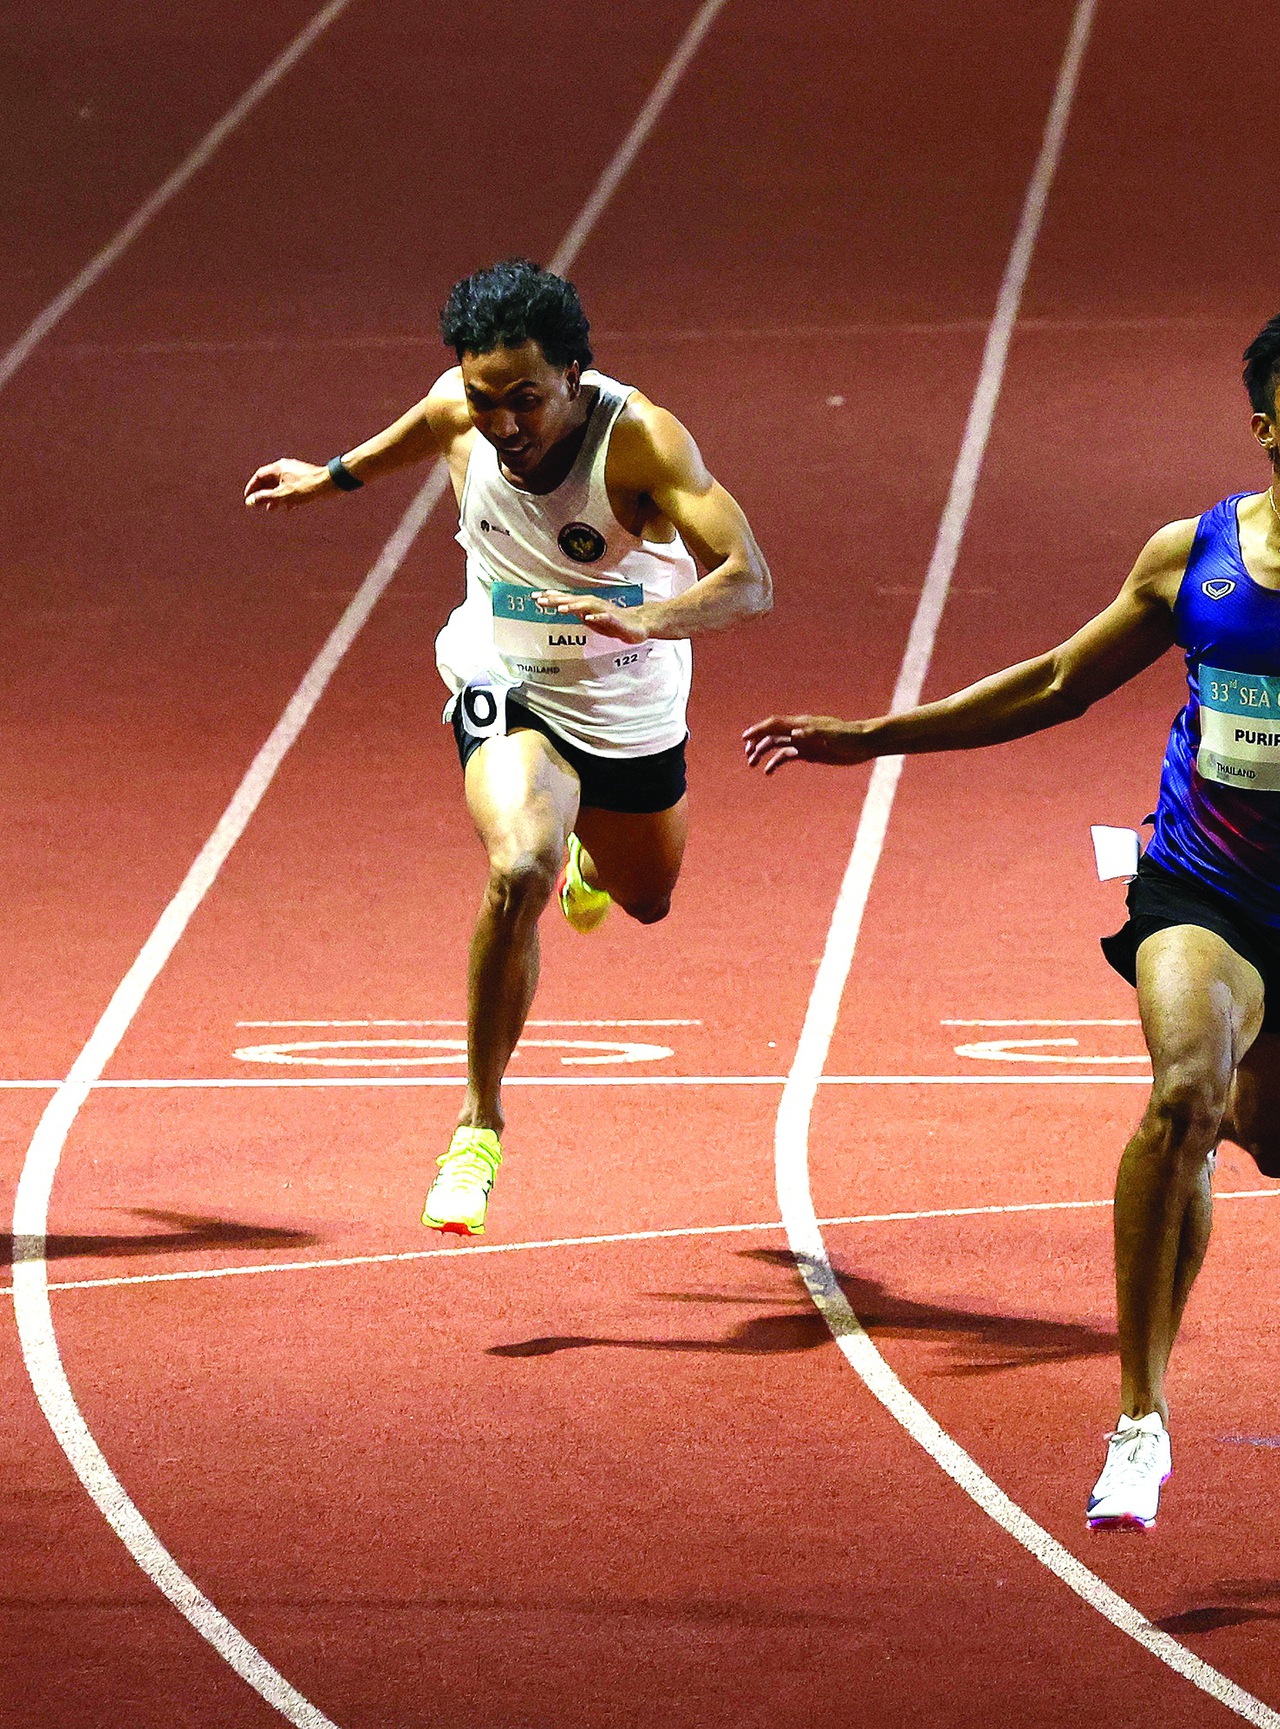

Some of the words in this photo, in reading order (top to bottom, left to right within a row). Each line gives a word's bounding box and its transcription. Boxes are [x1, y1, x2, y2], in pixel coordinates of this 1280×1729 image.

[548, 635, 587, 646] LALU
[614, 653, 639, 667] 122
[1210, 680, 1238, 702] 33rd
[1240, 687, 1271, 708] SEA
[1216, 762, 1257, 779] THAILAND
